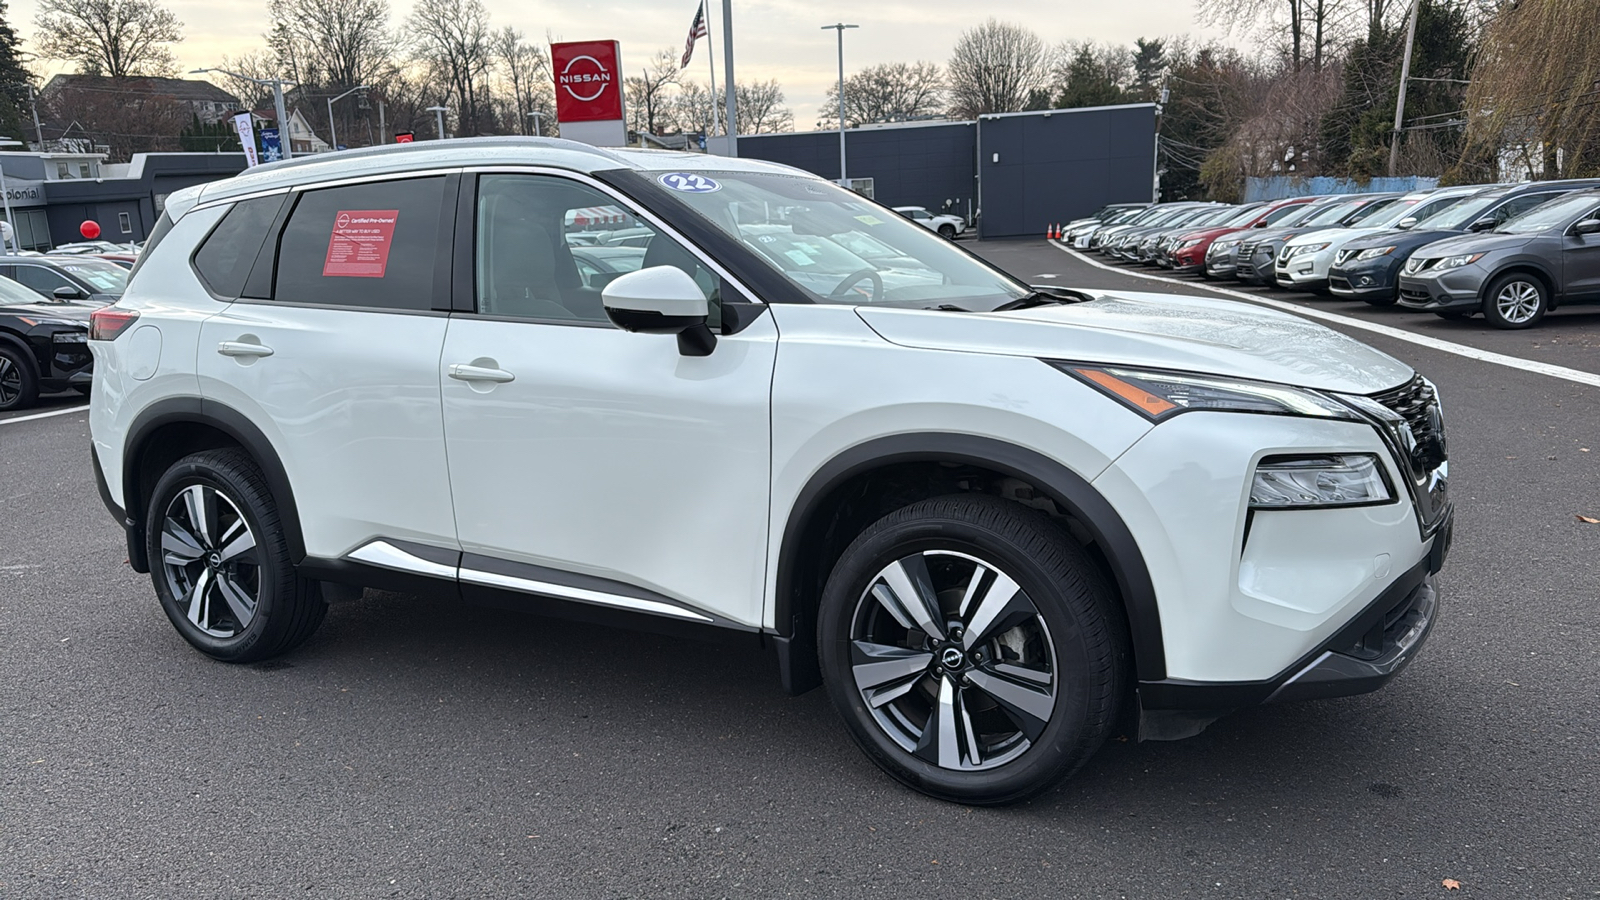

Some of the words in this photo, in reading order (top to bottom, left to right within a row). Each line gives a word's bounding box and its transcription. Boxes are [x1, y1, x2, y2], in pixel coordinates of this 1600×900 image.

[560, 73, 610, 83] NISSAN
[669, 174, 714, 190] 22
[2, 187, 39, 200] olonial
